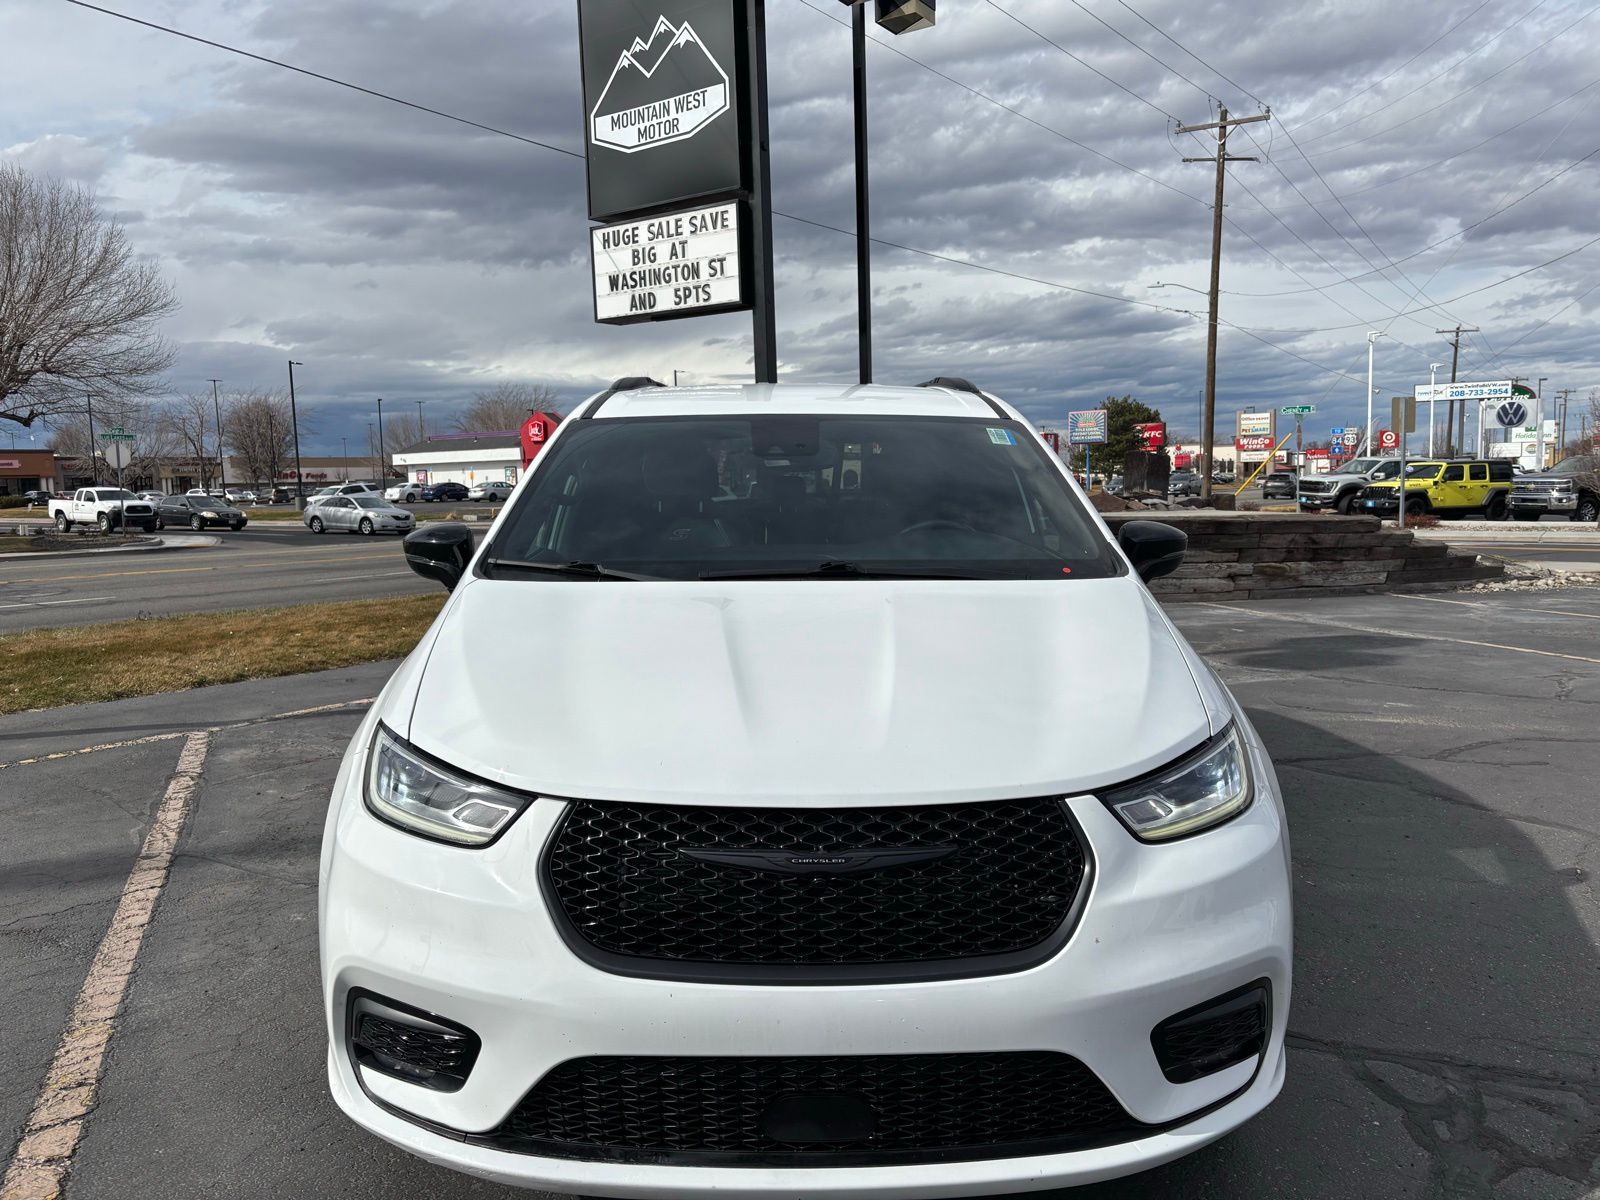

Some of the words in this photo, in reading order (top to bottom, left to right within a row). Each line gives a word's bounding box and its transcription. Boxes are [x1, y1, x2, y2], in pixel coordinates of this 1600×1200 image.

[610, 100, 671, 132] MOUNTAIN
[674, 90, 708, 115] WEST
[637, 117, 680, 143] MOTOR
[602, 226, 640, 250] HUGE
[647, 217, 684, 242] SALE
[688, 210, 729, 235] SAVE
[631, 245, 657, 267] BIG
[669, 240, 688, 261] AT
[608, 261, 701, 292] WASHINGTON
[707, 256, 727, 278] ST
[629, 291, 657, 312] AND
[673, 283, 712, 306] 5PTS
[1449, 388, 1509, 398] 208-733-2954
[1143, 430, 1163, 438] KFC
[1240, 437, 1270, 445] WinCo
[1345, 436, 1356, 444] 93
